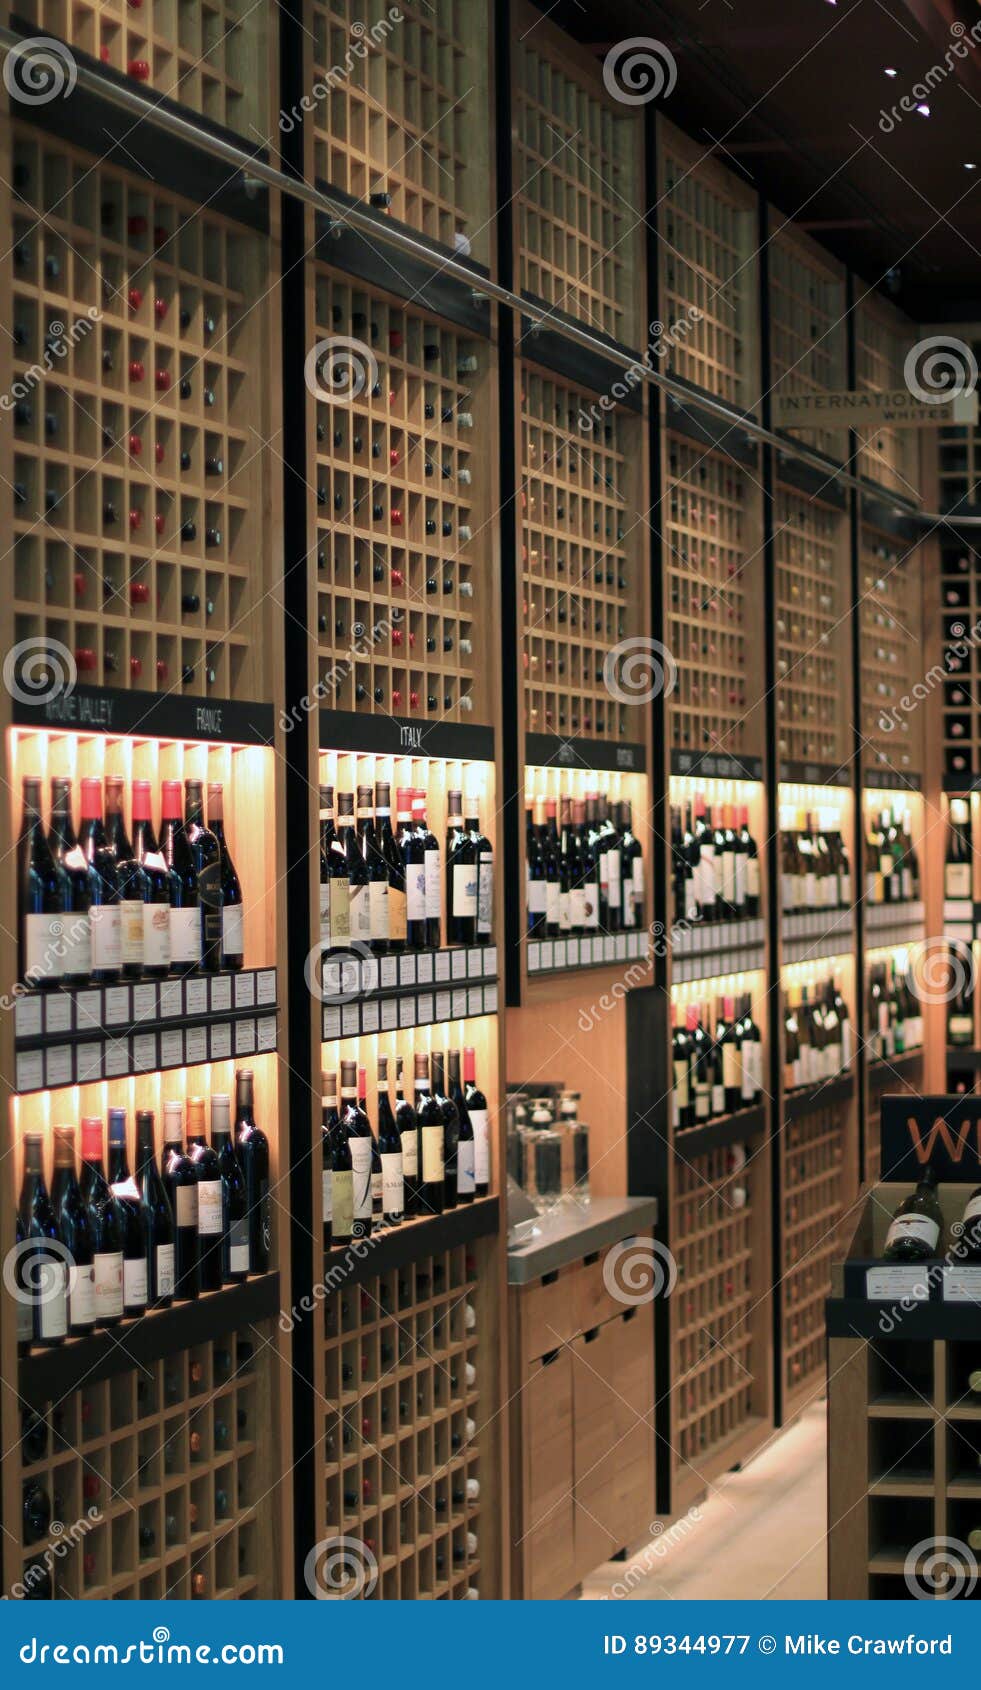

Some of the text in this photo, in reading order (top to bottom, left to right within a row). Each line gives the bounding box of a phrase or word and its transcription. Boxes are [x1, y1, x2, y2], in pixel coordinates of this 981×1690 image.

[79, 696, 112, 724] VALLEY
[196, 707, 222, 733] FRANCE
[400, 726, 422, 748] ITALY
